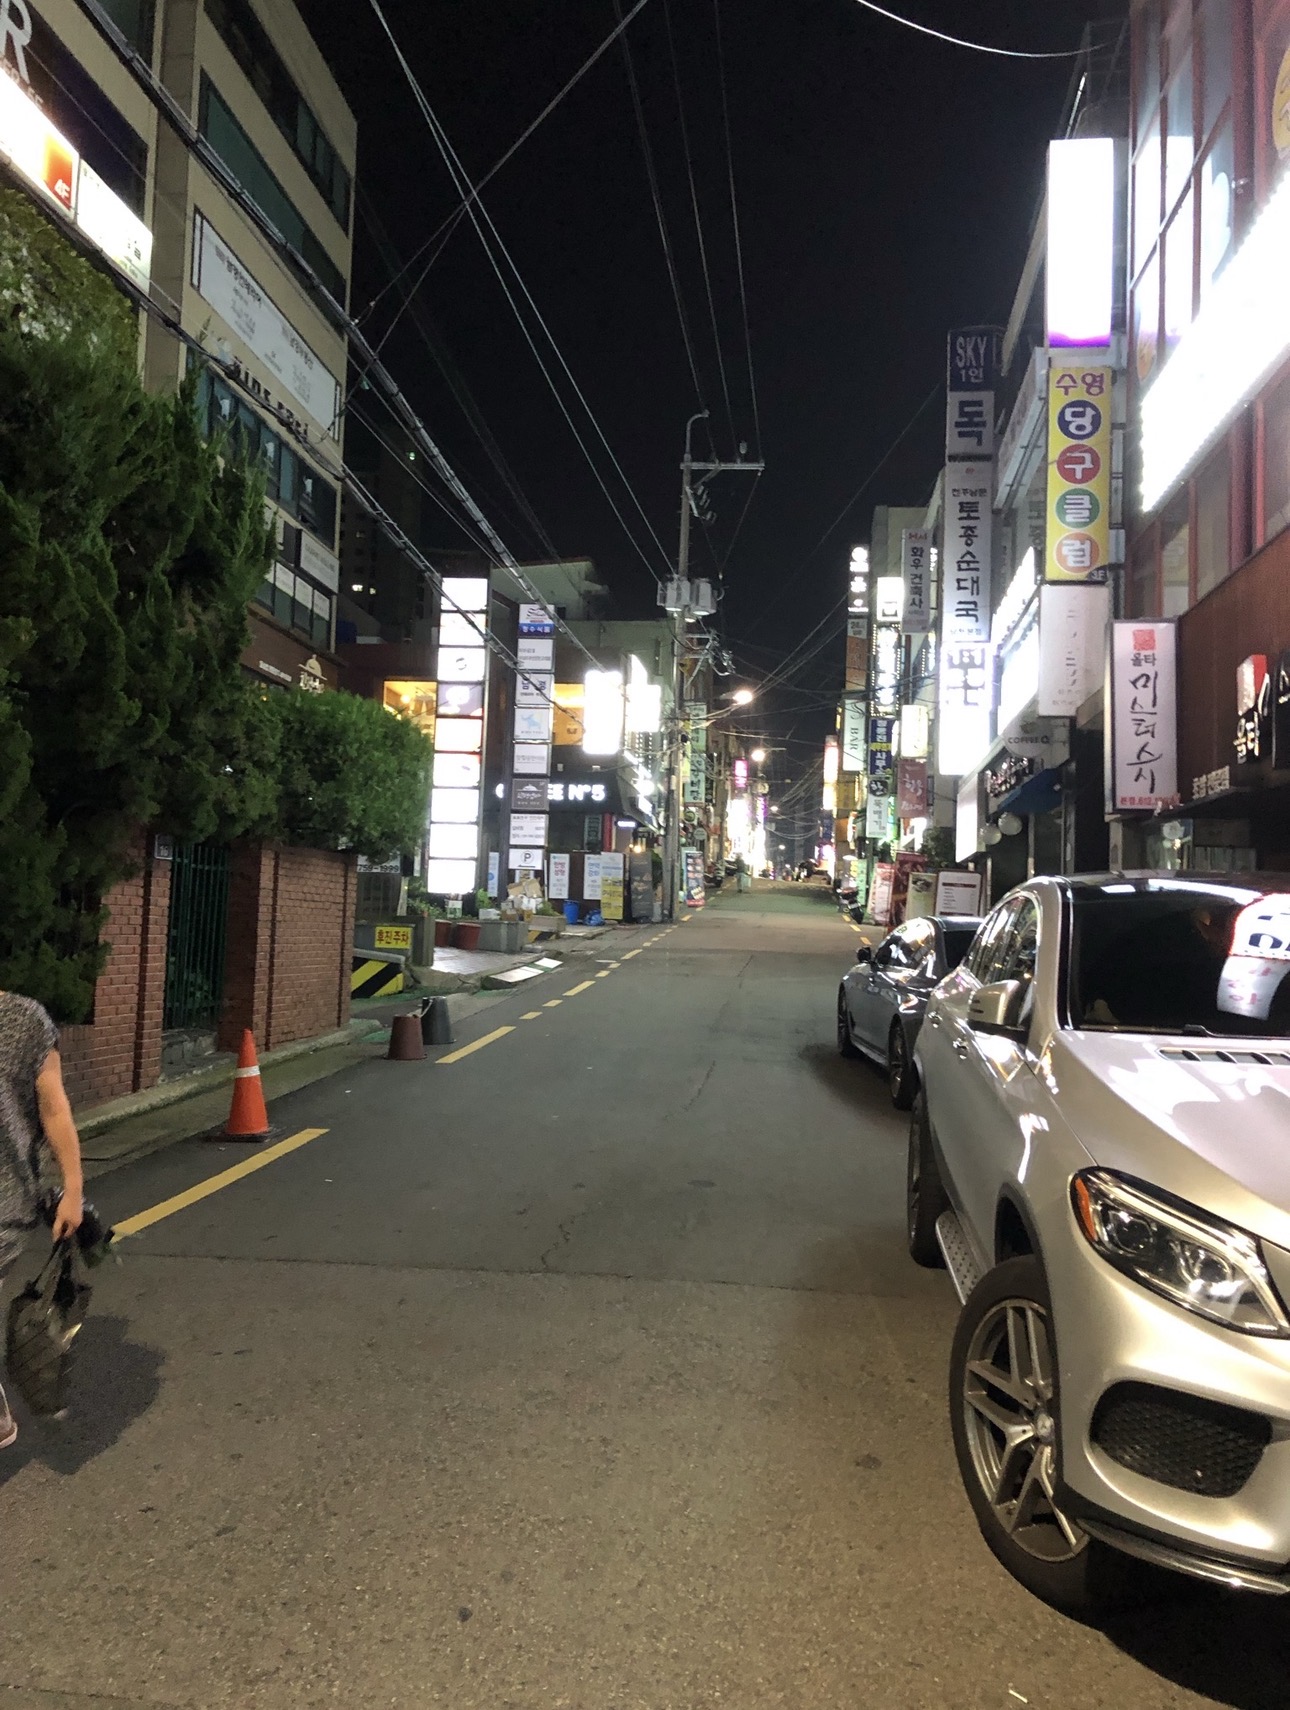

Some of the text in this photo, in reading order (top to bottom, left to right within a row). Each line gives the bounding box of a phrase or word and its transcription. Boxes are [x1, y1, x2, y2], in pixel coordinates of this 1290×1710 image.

[54, 178, 71, 200] 4F
[956, 336, 987, 368] SKY
[960, 367, 984, 383] 1인
[1056, 373, 1104, 397] 수영
[954, 400, 987, 446] 독
[1062, 406, 1097, 568] 당구클럽
[910, 547, 924, 570] 화우
[955, 501, 980, 623] 토종순대국
[1091, 570, 1105, 580] 3F
[1131, 652, 1157, 667] 올타
[849, 727, 860, 750] BAR
[1126, 671, 1163, 794] 미스터스시
